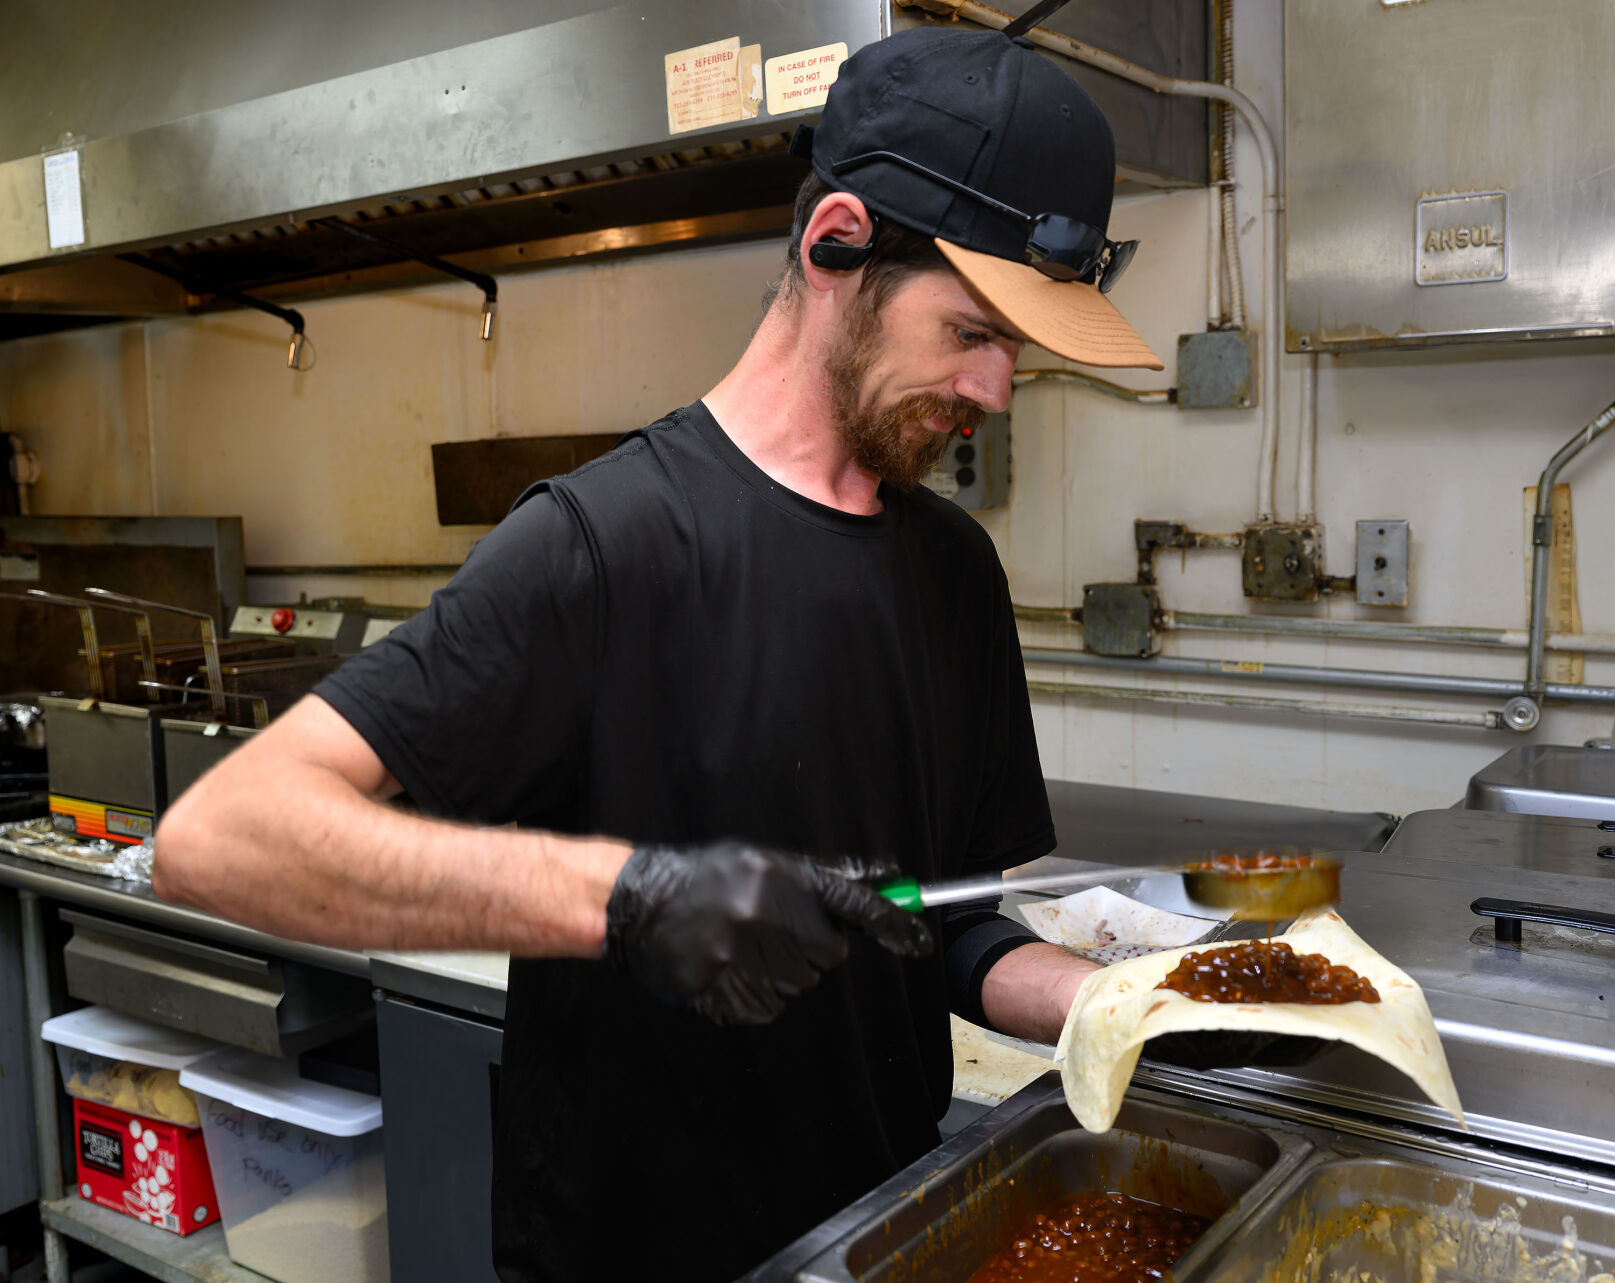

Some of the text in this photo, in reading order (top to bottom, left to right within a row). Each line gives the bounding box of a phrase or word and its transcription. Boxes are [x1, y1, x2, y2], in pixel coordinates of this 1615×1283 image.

[673, 63, 687, 74] A-1
[777, 53, 835, 73] IN CASE OF FIRE
[793, 71, 821, 85] DO NOT
[782, 89, 802, 100] TURN
[803, 85, 818, 96] OFF
[1424, 223, 1500, 253] ANSUL
